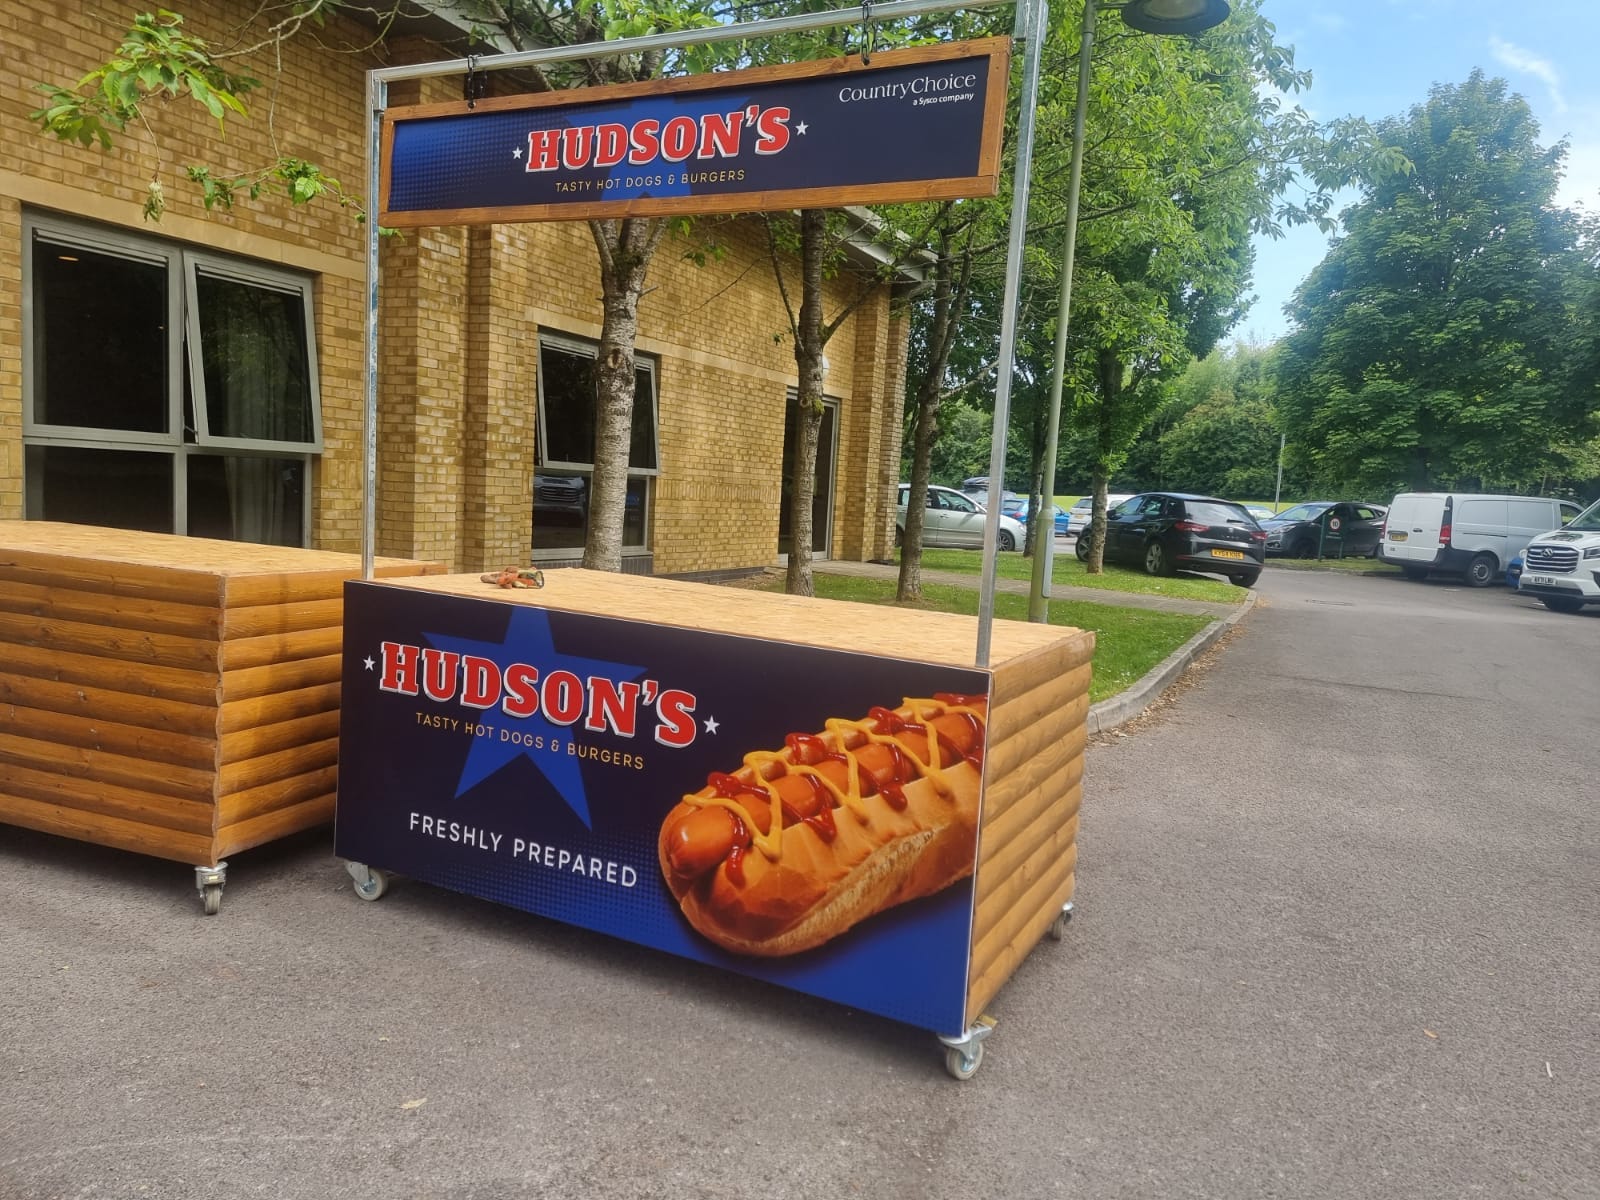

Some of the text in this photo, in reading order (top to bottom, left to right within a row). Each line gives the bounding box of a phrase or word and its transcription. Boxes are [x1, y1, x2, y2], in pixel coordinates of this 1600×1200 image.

[839, 73, 976, 103] CountryChoice
[919, 96, 938, 106] Sysco
[938, 93, 974, 104] company
[525, 105, 791, 173] HUDSON'S
[555, 169, 745, 193] TASTY HOT DOGS & BURGERS
[379, 641, 697, 749] HUDSON'S
[415, 712, 644, 770] TASTY HOT DOGS & BURGERS
[410, 812, 637, 888] FRESHLY PREPARED
